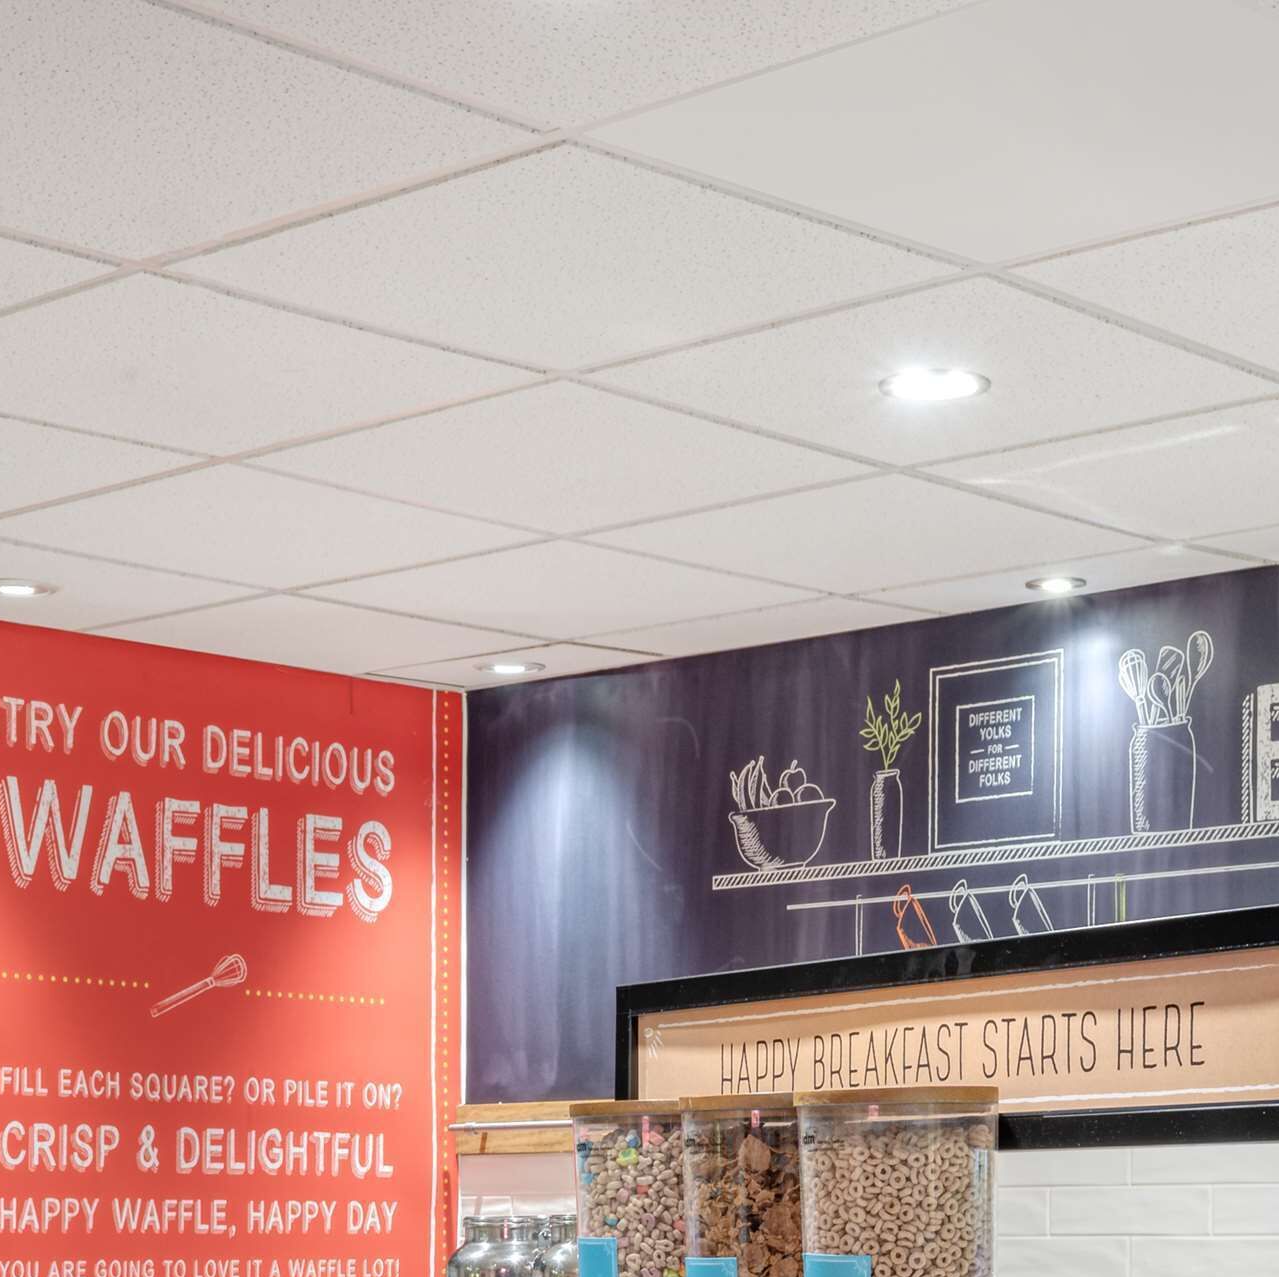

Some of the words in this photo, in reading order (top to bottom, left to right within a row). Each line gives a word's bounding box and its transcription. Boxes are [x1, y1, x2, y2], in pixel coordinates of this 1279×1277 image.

[969, 708, 1022, 727] DIFFERENT
[980, 725, 1011, 741] YOLKS
[100, 710, 186, 768] OUR
[202, 725, 395, 796] DELICIOUS
[969, 755, 1022, 773] DIFFERENT
[987, 744, 1003, 754] FOR
[979, 772, 1011, 788] FOLKS
[721, 1037, 801, 1095] HAPPY
[813, 1022, 968, 1091] BREAKFAST
[982, 1011, 1097, 1079] STARTS
[1117, 1001, 1205, 1071] HERE
[0, 1066, 48, 1096] FILL
[58, 1069, 120, 1098] EACH
[129, 1073, 235, 1104] SQUARE?
[244, 1077, 275, 1104] OR
[283, 1079, 328, 1107] PILE
[336, 1081, 355, 1107] IT
[362, 1083, 403, 1110] ON?
[136, 1124, 159, 1174] &
[175, 1127, 395, 1178] DELIGHTFUL
[112, 1199, 236, 1240] WAFFLE,
[247, 1200, 337, 1235] HAPPY
[347, 1201, 398, 1234] DAY
